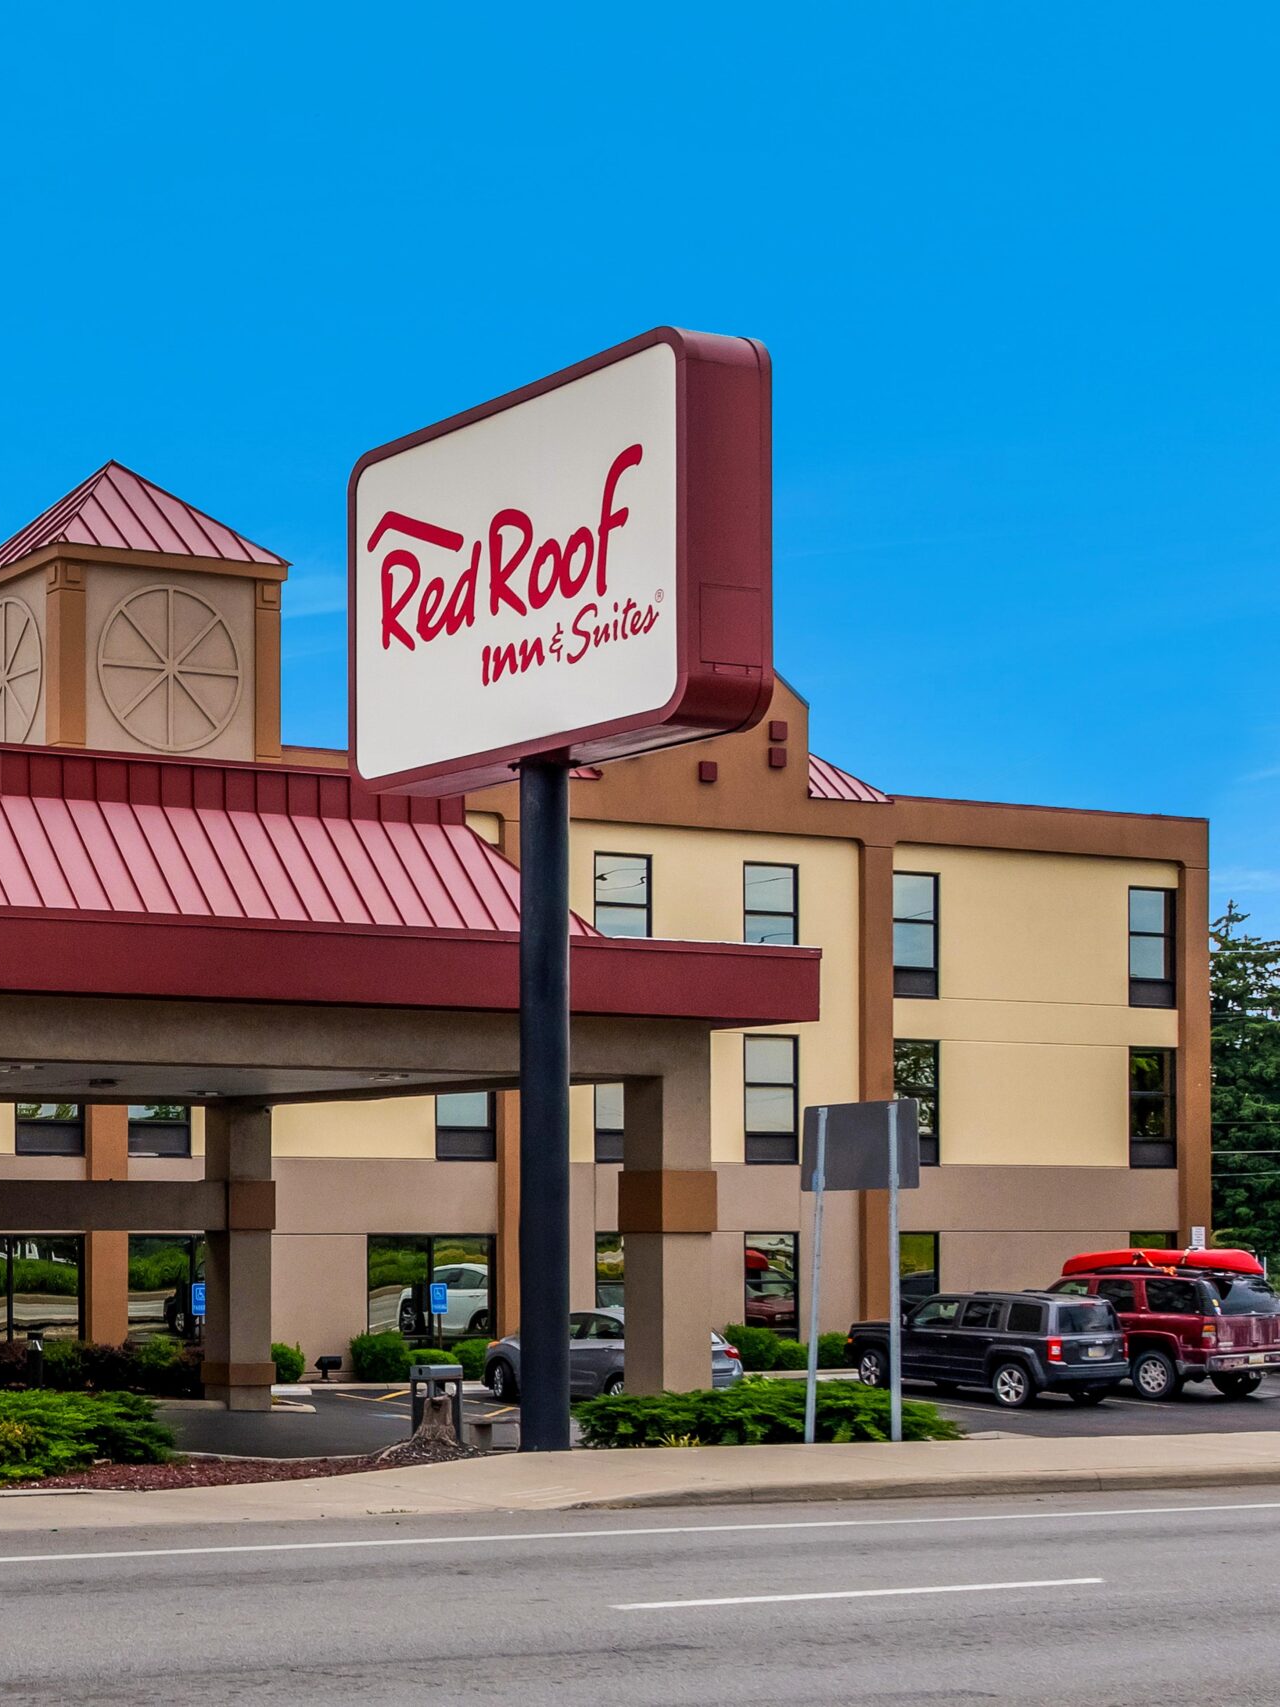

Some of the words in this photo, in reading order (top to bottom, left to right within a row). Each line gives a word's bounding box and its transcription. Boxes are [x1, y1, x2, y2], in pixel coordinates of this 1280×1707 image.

[380, 540, 482, 651] Red
[488, 443, 643, 617] Roof
[481, 636, 545, 687] Inn
[549, 622, 564, 662] &
[566, 598, 660, 665] Suites
